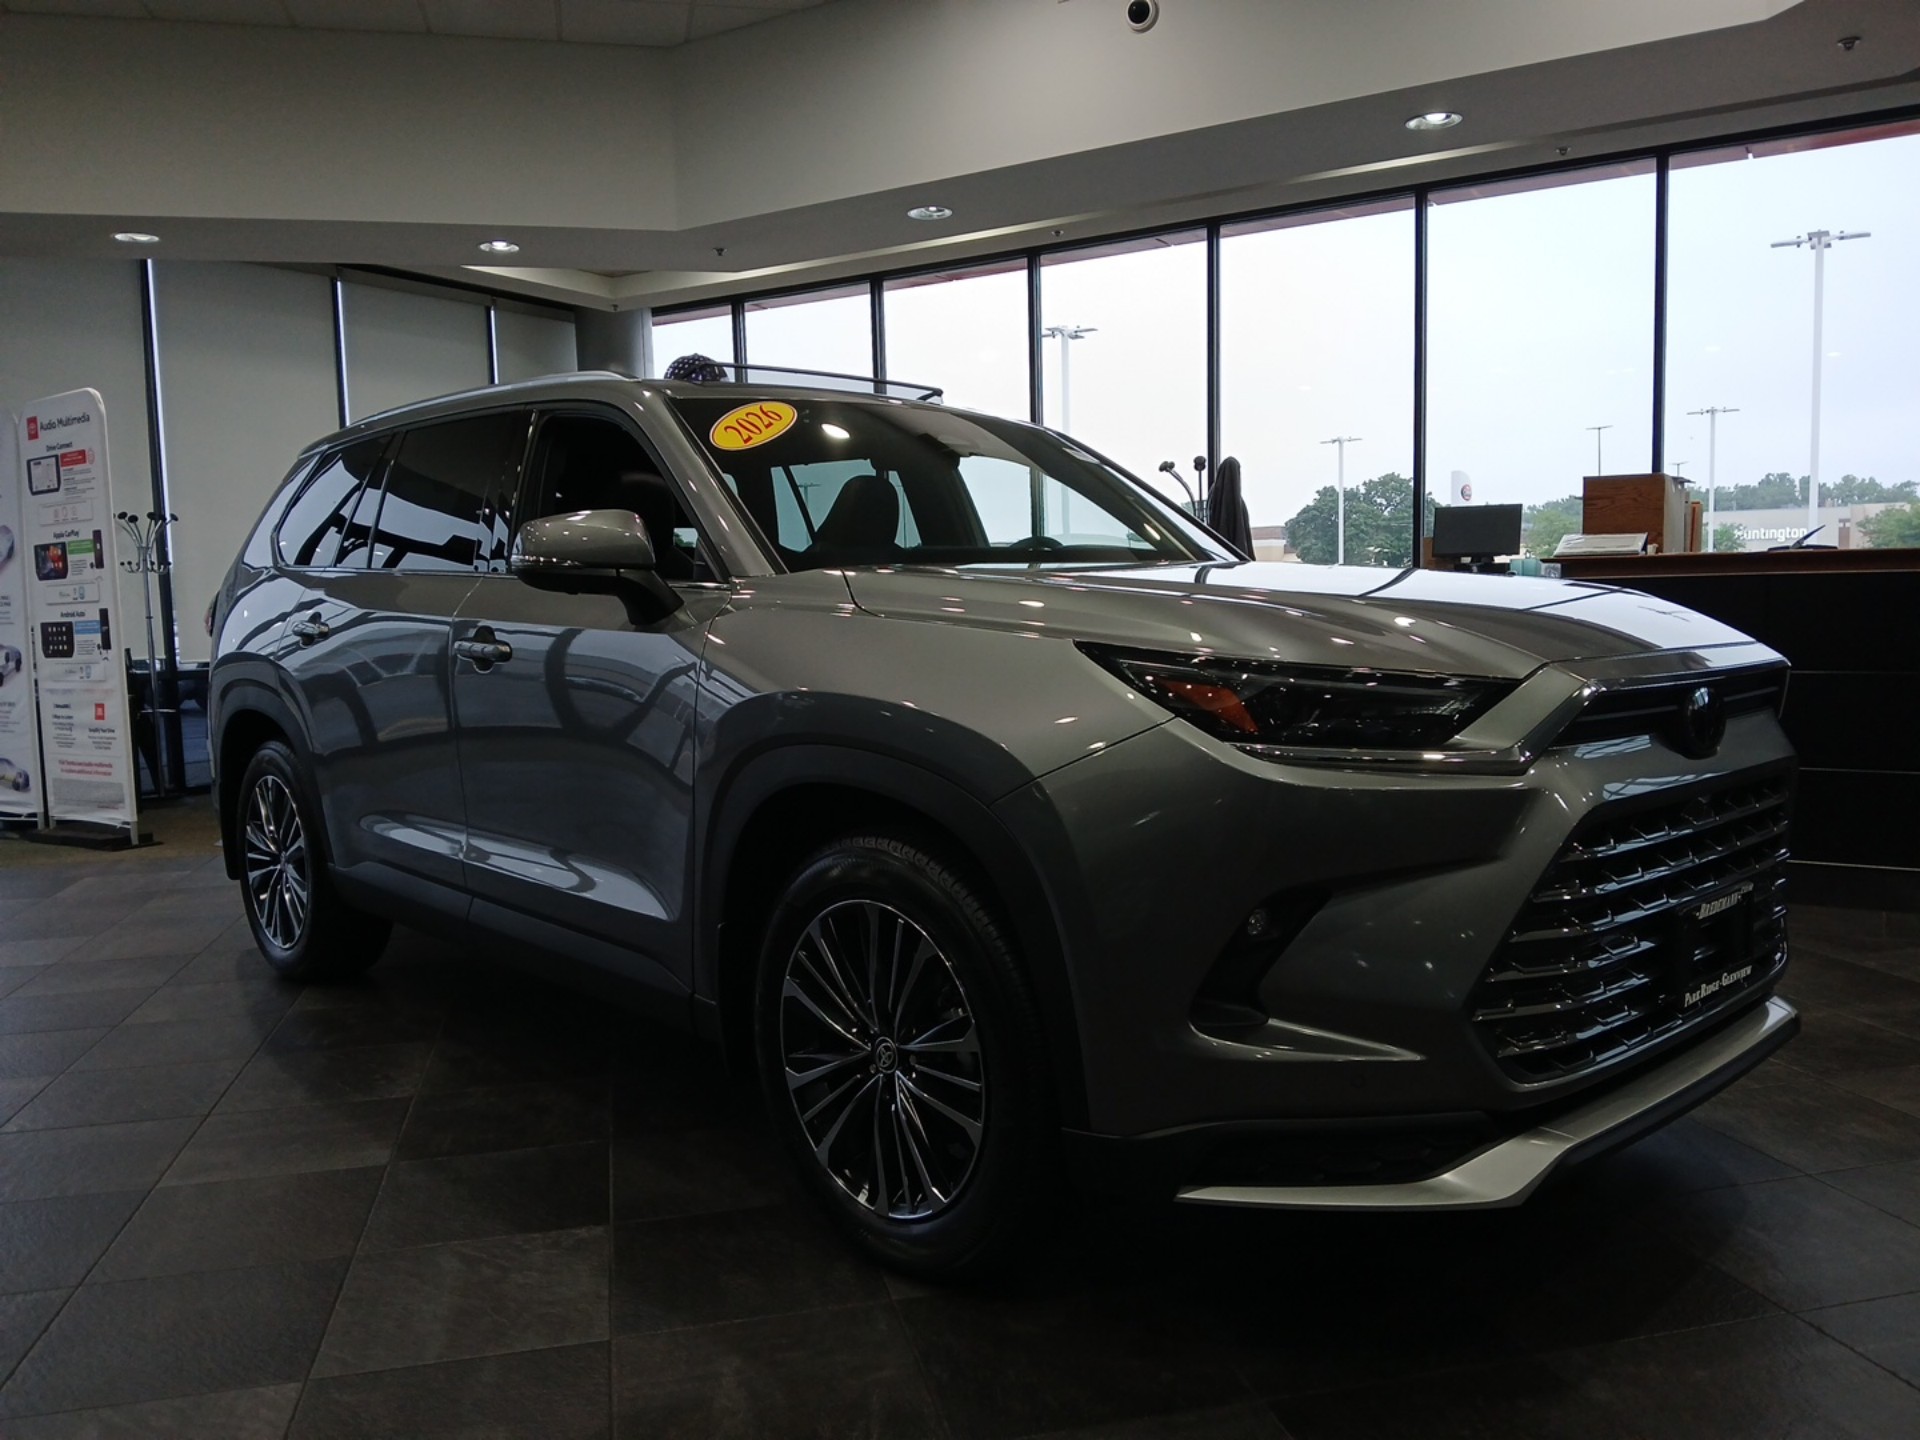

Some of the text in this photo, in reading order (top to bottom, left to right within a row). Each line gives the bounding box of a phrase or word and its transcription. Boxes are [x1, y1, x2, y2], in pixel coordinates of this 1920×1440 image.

[40, 412, 90, 431] Audio Multimedia
[724, 404, 783, 445] 2026
